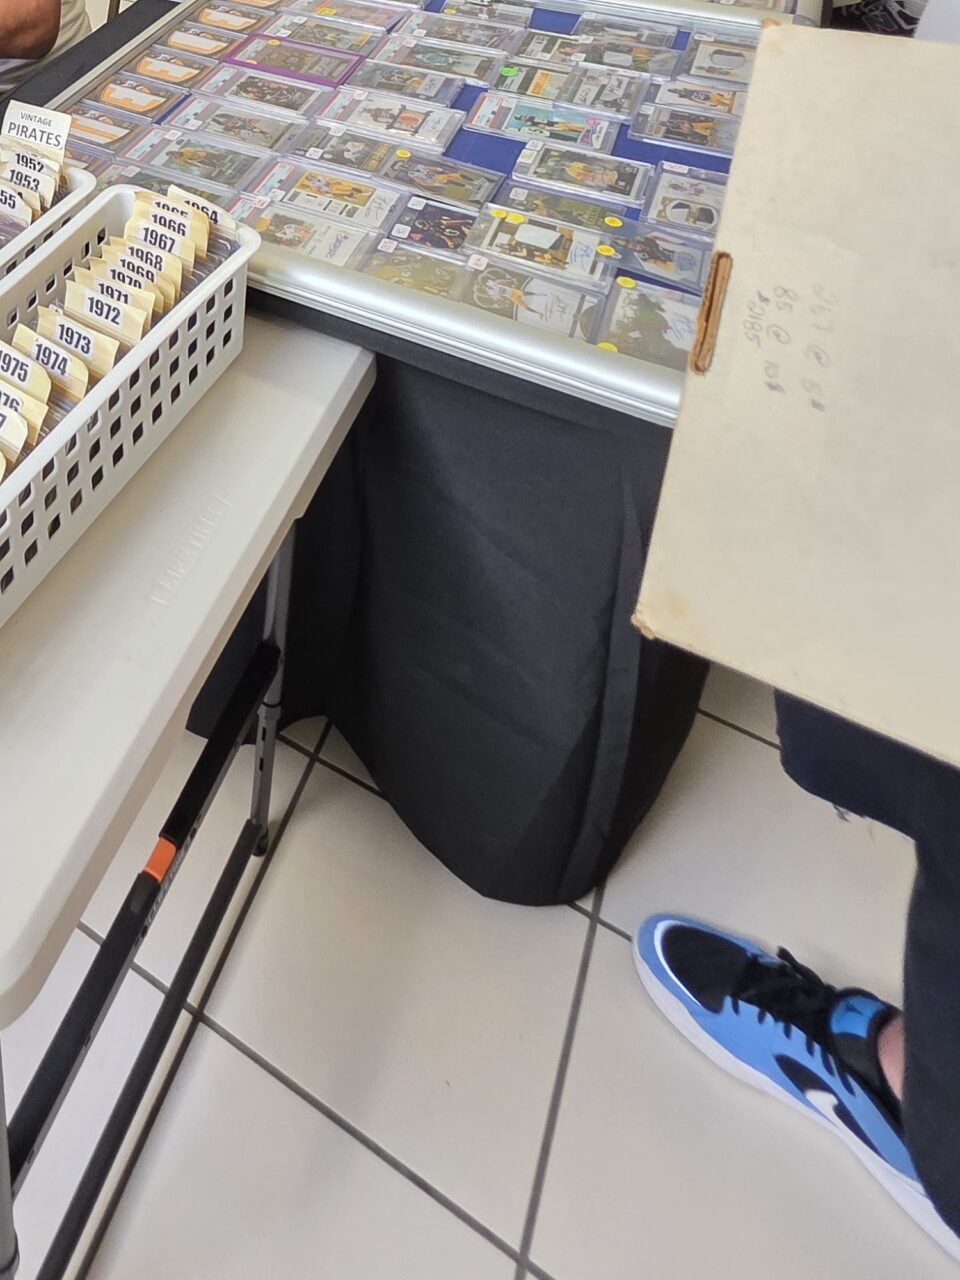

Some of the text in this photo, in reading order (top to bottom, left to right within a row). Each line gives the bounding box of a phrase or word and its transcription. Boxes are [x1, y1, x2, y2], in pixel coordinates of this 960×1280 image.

[20, 111, 52, 127] VINTAGE
[8, 122, 62, 148] PIRATES
[15, 153, 44, 173] 1952
[9, 169, 40, 193] 1953
[152, 214, 187, 237] 1966
[142, 227, 176, 253] 1967
[128, 246, 163, 271] 1968
[97, 282, 130, 304] 1971
[87, 296, 121, 325] 1972
[57, 323, 92, 355] 1973
[34, 342, 68, 376] 1974
